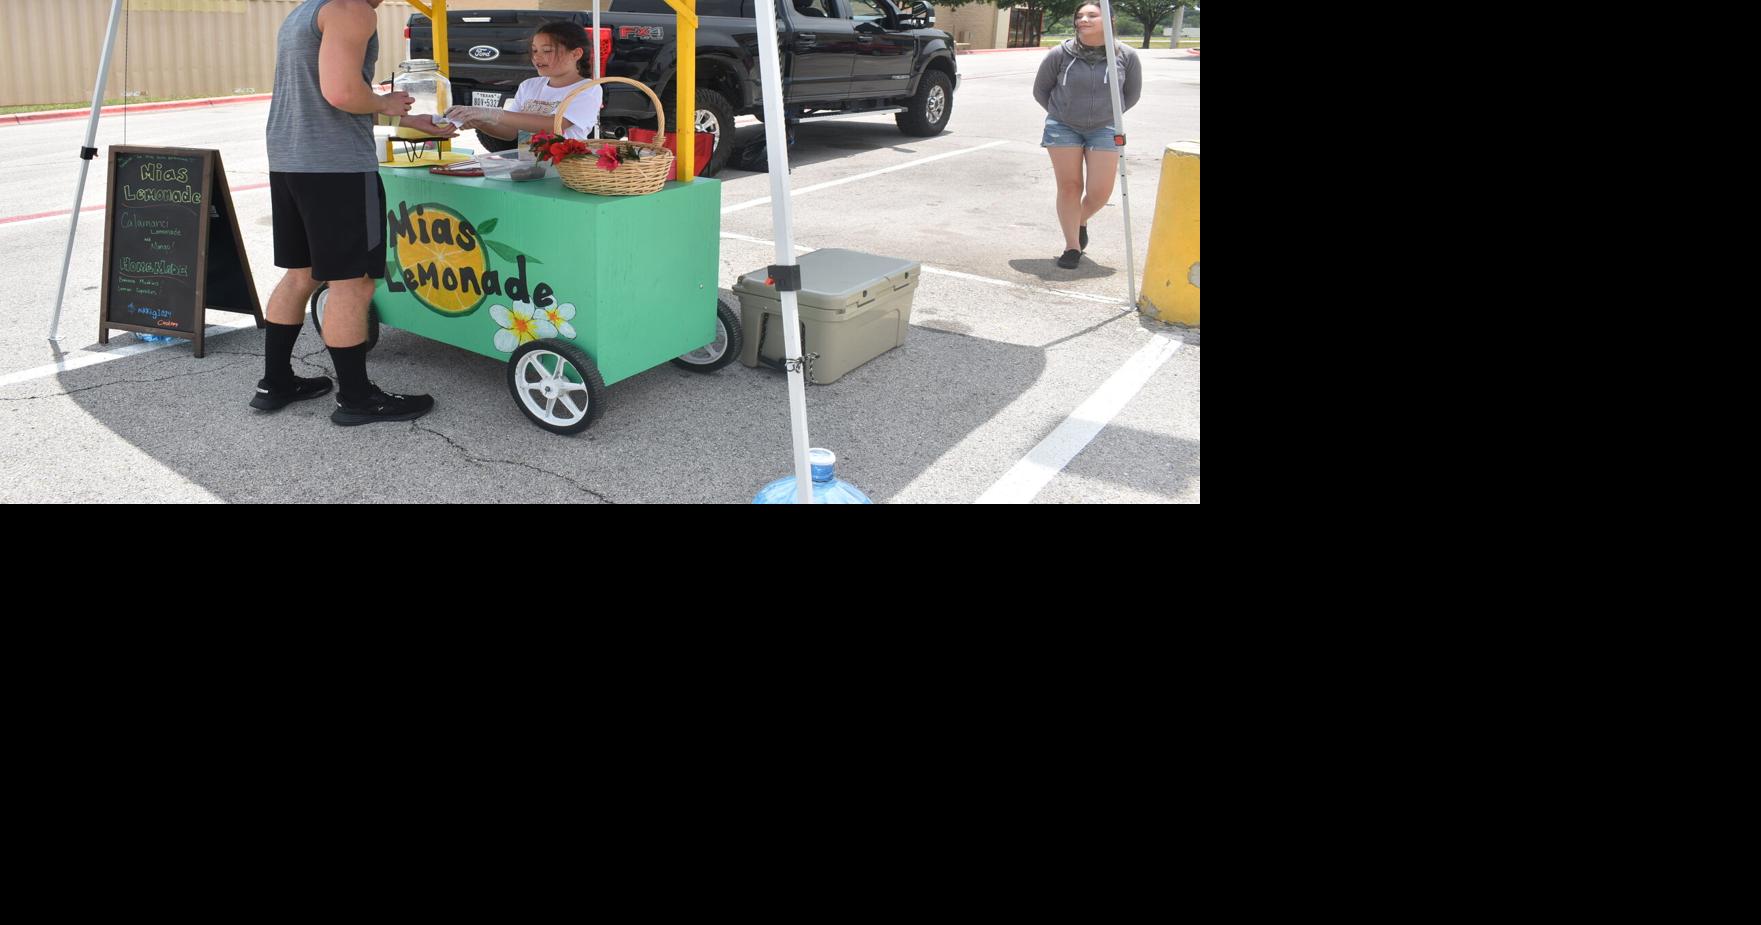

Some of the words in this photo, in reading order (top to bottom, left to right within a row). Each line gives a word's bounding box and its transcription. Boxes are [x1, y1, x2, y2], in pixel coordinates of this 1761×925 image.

[619, 25, 665, 40] FX4
[141, 163, 188, 184] Mias
[388, 201, 477, 252] Mias
